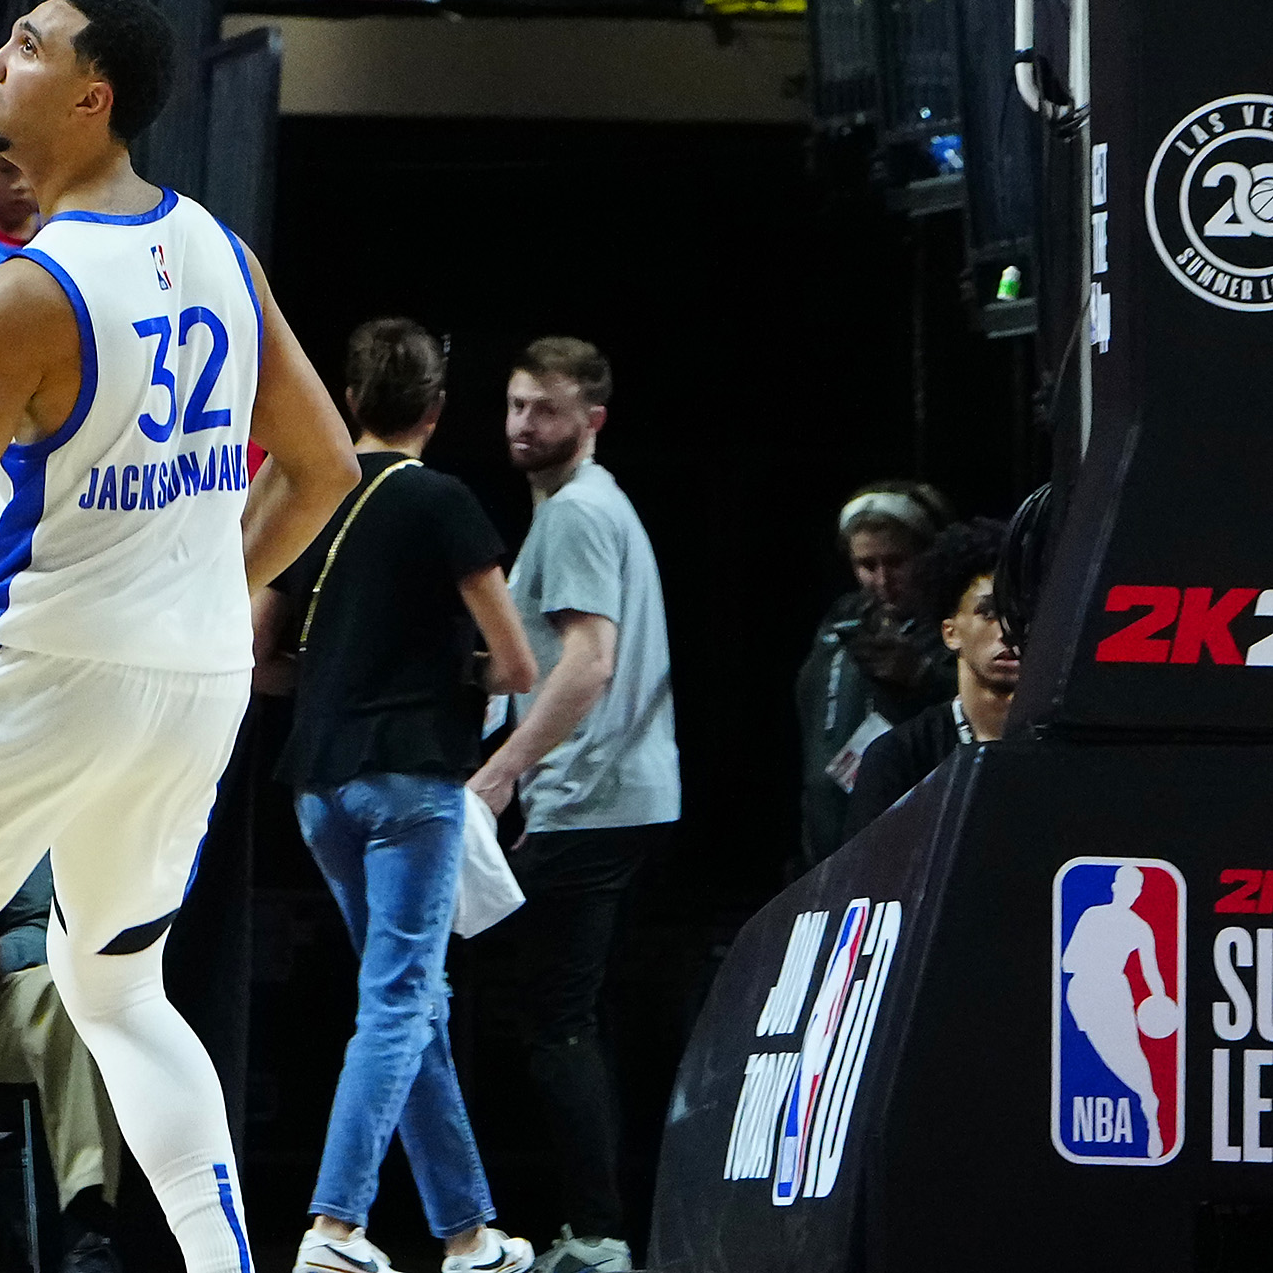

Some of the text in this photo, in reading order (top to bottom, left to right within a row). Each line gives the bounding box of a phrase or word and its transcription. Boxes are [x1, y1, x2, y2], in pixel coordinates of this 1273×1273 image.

[1175, 112, 1226, 157] LAS
[1175, 247, 1253, 300] SUMMER
[132, 305, 232, 444] 32
[1072, 1095, 1134, 1155] NBA
